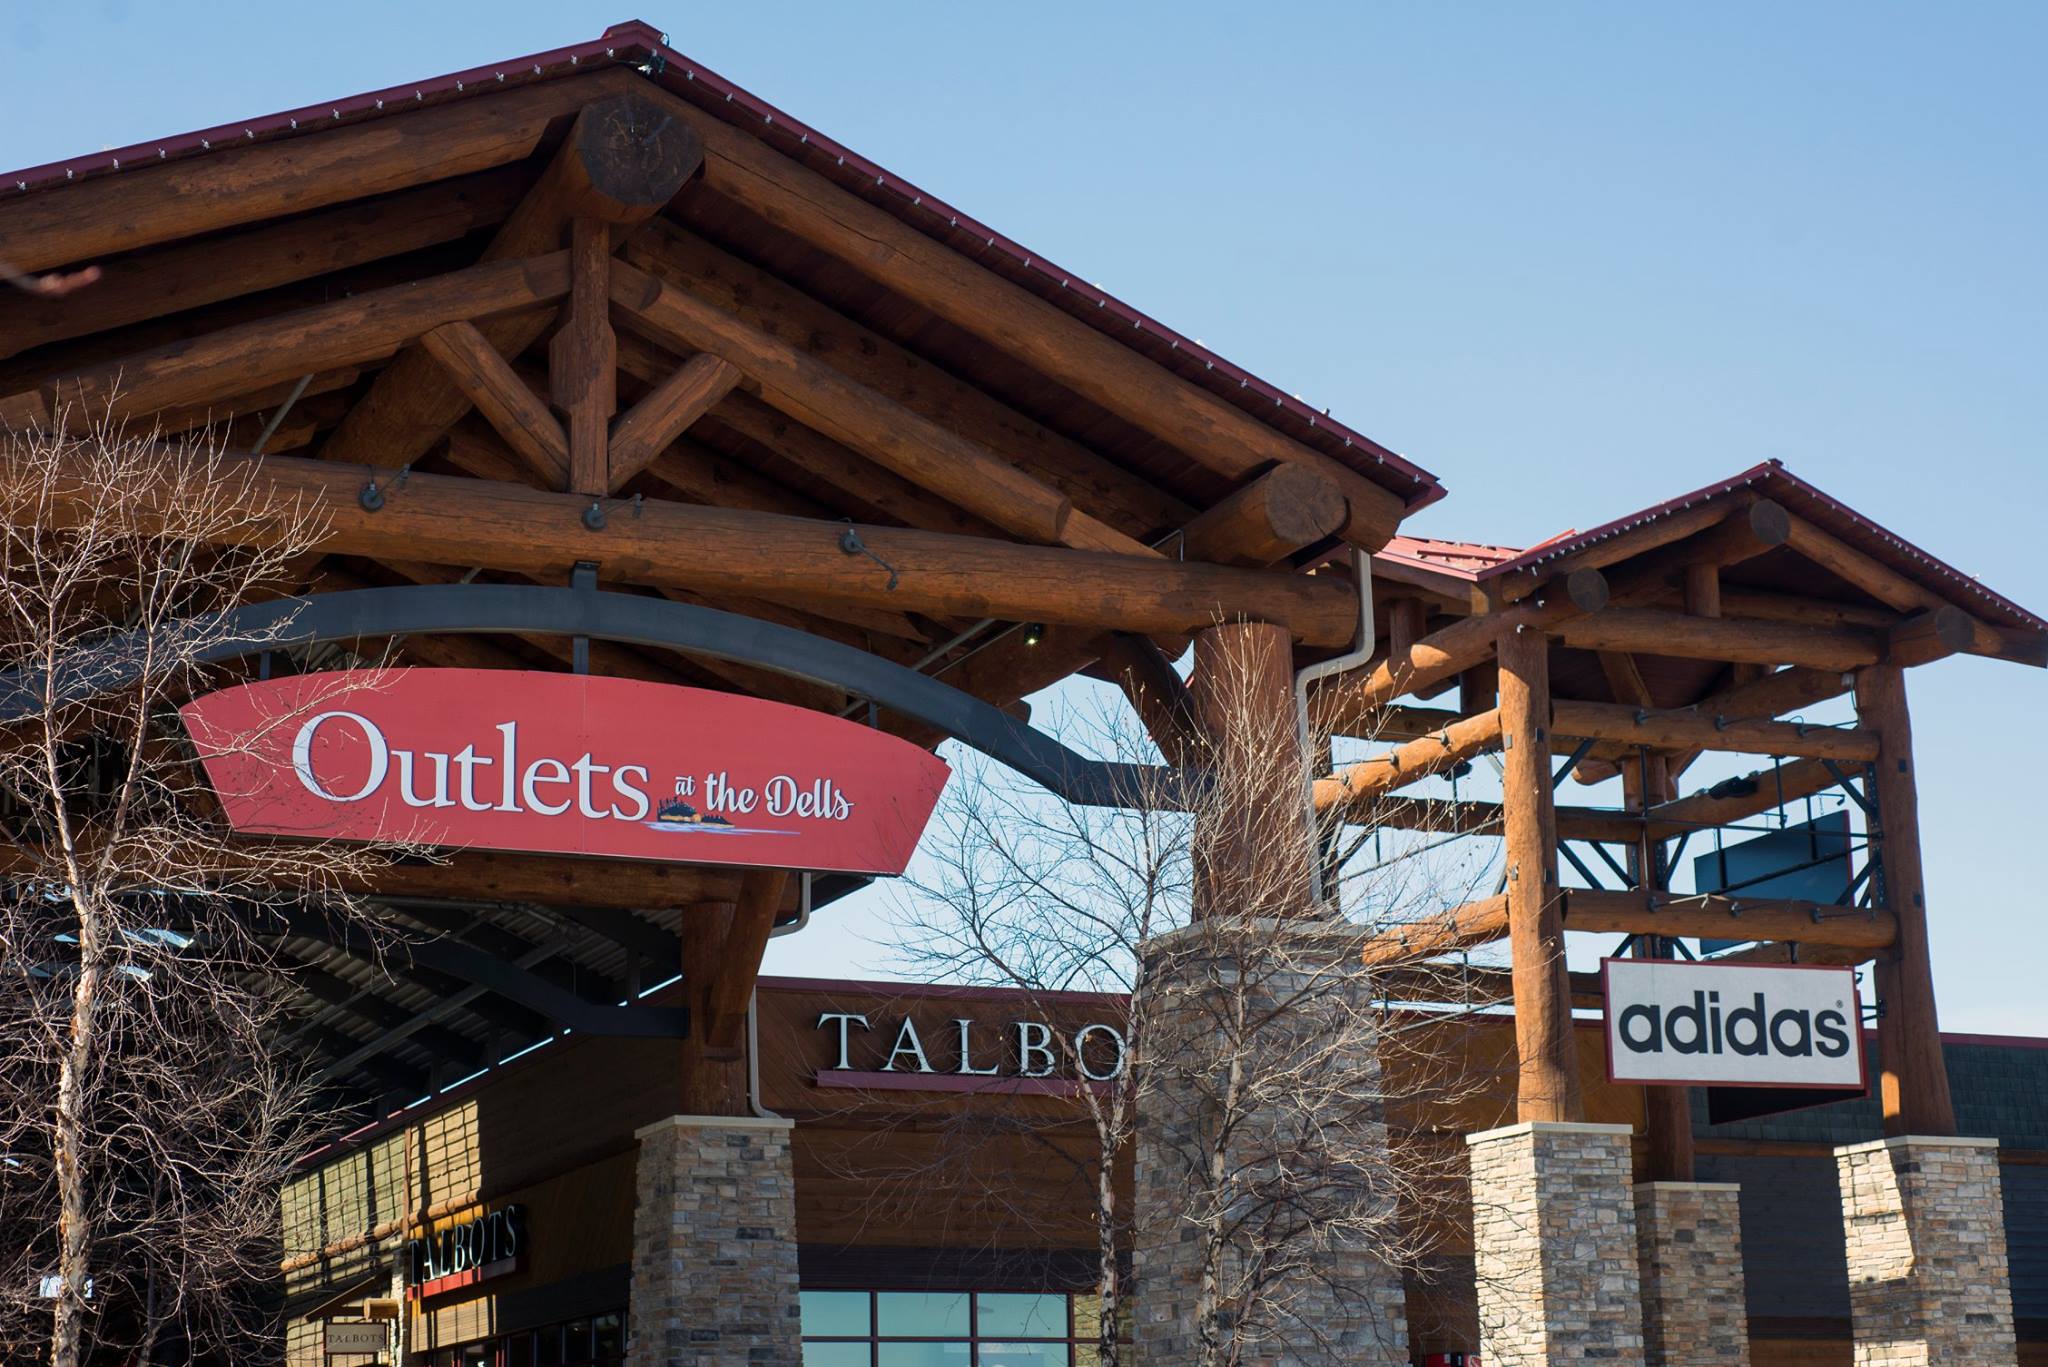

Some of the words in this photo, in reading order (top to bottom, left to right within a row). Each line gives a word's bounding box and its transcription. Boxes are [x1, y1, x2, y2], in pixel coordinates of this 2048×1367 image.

[292, 711, 650, 821] Outlets
[674, 775, 696, 796] at
[704, 771, 759, 814] the
[765, 775, 855, 821] Dells
[1619, 990, 1850, 1058] adidas
[408, 1204, 517, 1288] TALBOTS
[327, 1334, 385, 1344] TALBOTS
